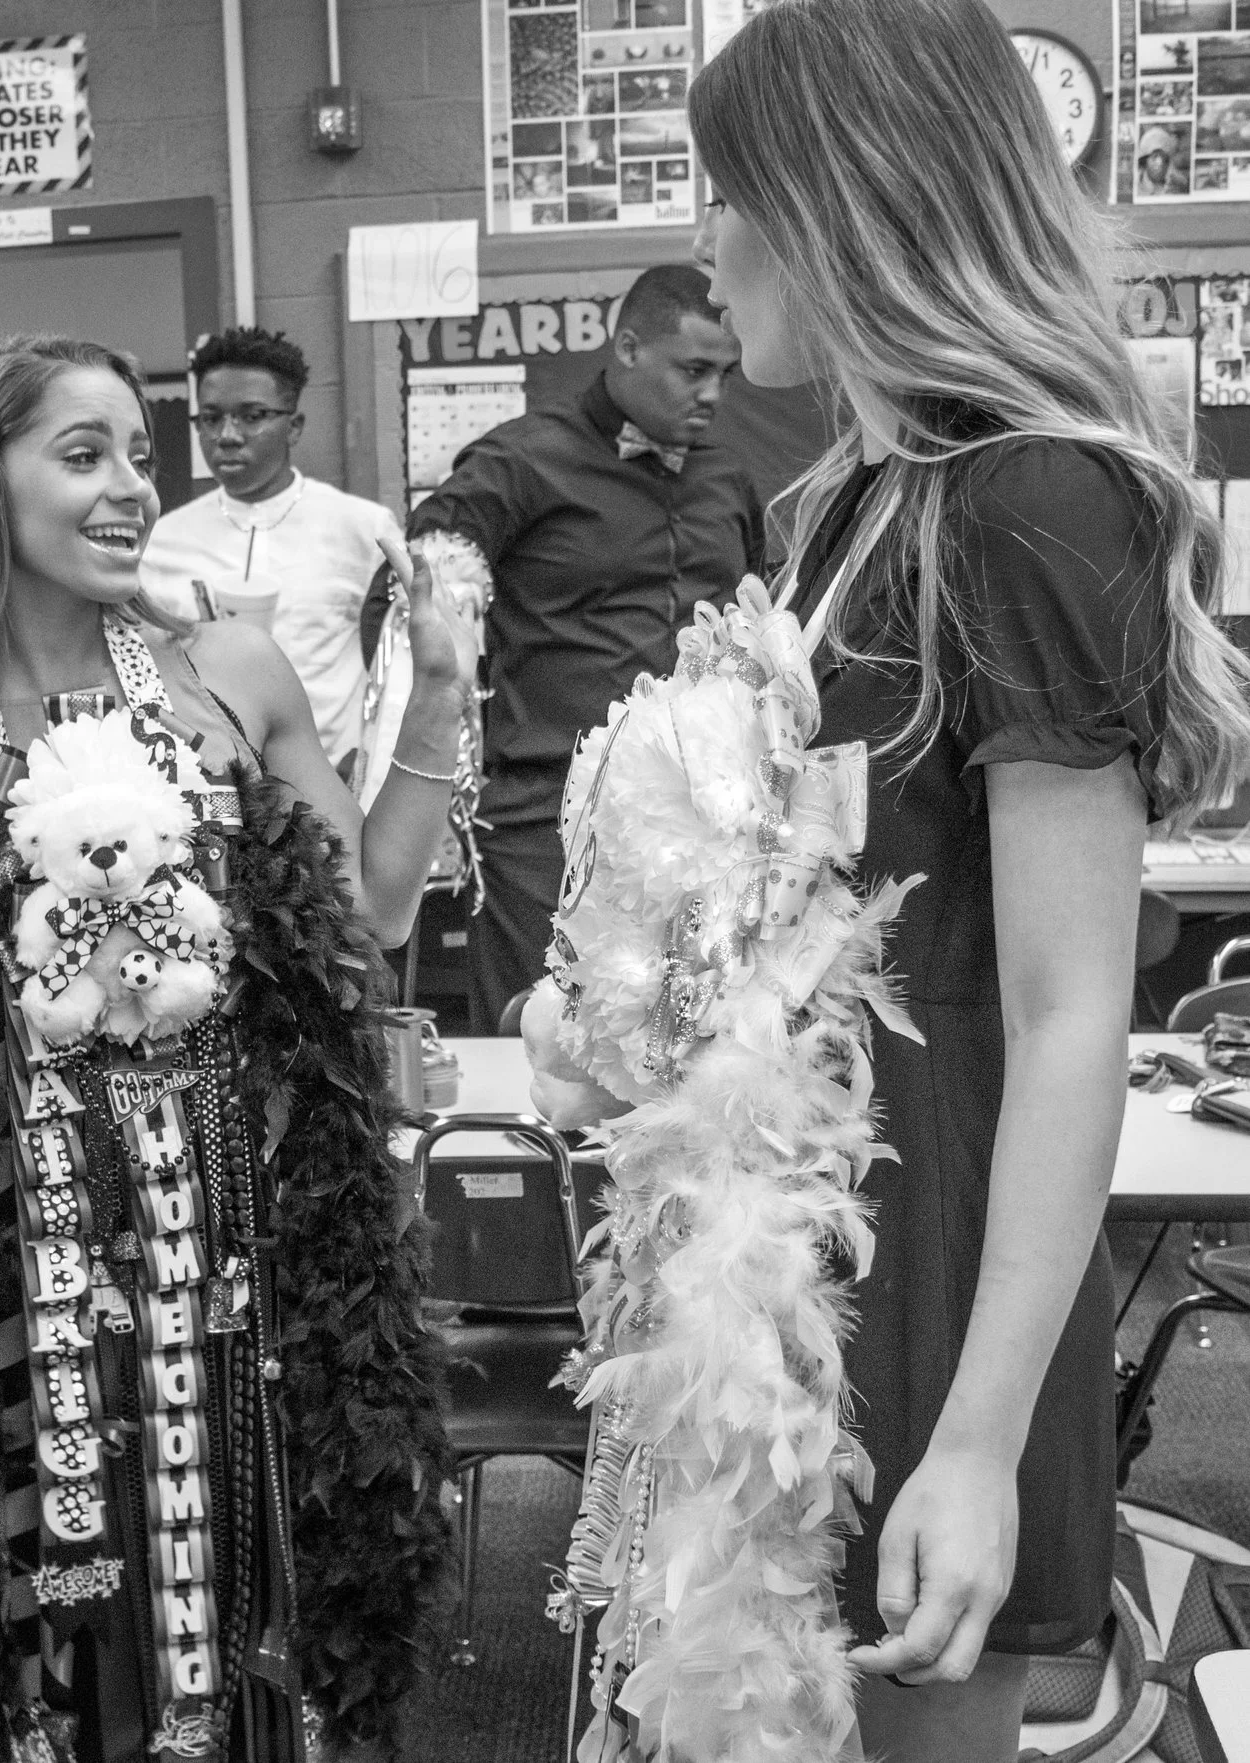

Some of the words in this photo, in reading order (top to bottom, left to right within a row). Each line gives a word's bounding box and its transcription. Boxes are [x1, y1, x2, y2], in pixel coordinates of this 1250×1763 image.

[1042, 50, 1049, 70] 1
[1060, 68, 1074, 89] 2
[1069, 98, 1083, 119] 3
[140, 1125, 210, 1695] HOMECOMING
